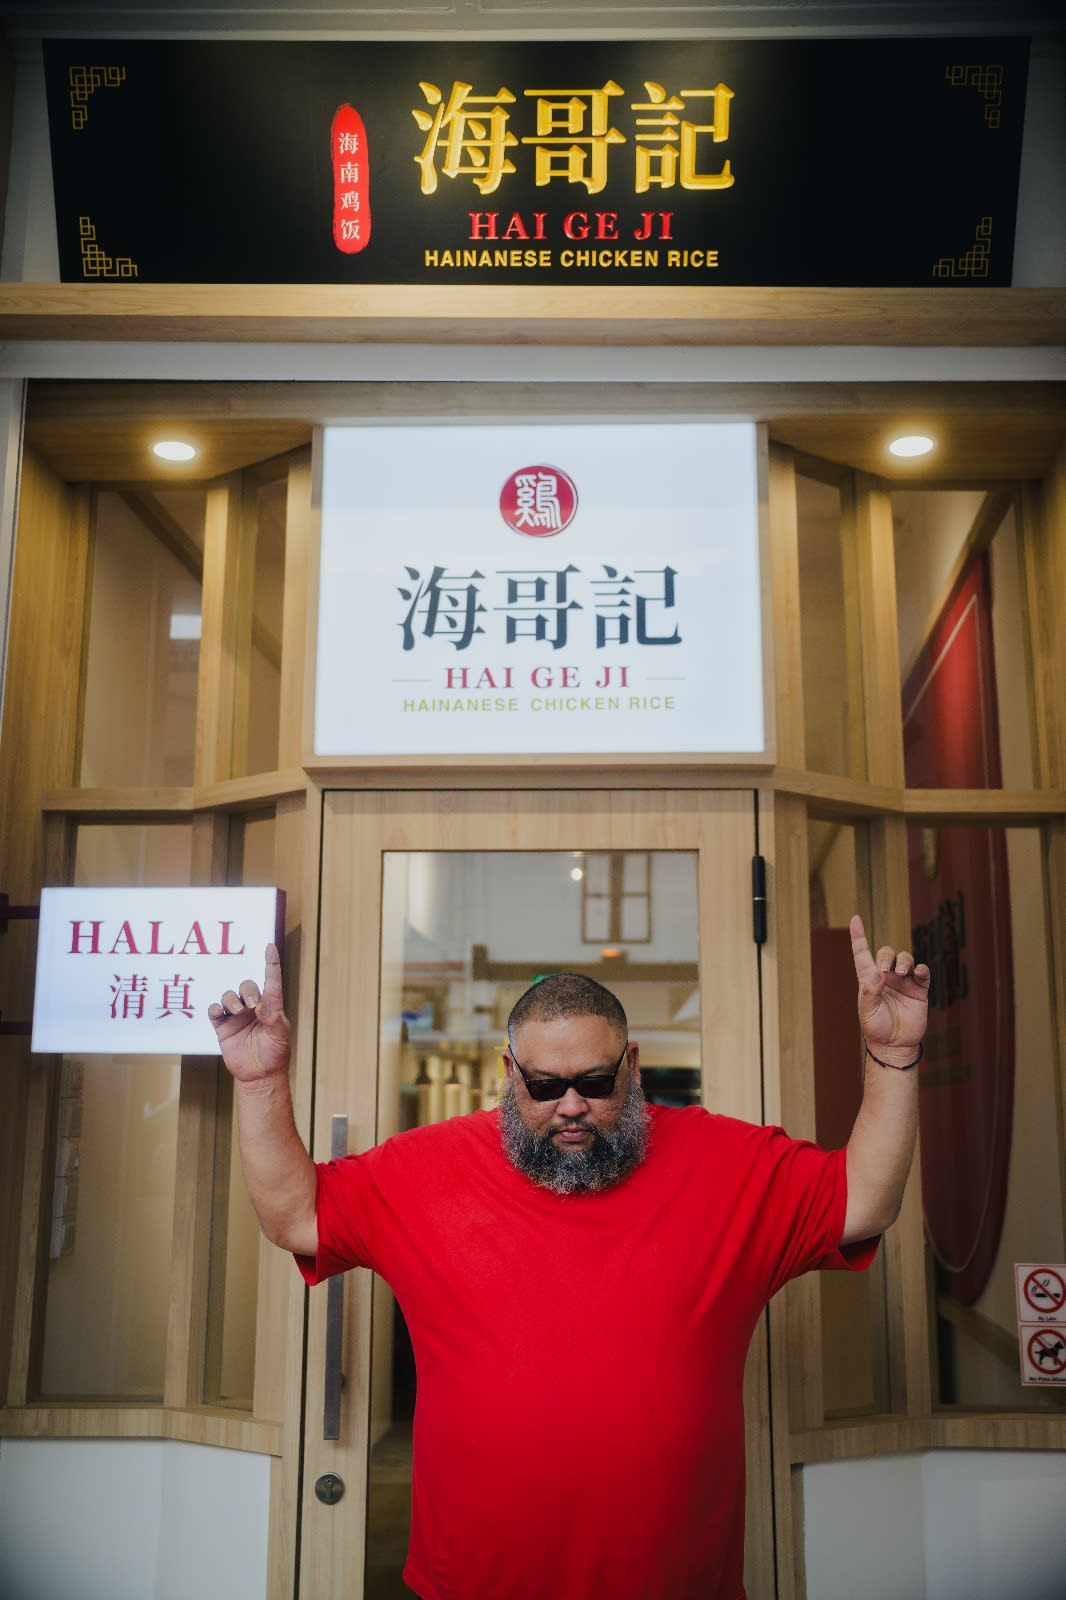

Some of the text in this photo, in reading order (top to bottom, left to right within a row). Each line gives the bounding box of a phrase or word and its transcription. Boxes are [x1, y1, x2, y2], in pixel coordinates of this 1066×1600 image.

[412, 80, 735, 195] 海哥記
[339, 132, 361, 241] 海南鸡饭
[468, 211, 674, 240] HAI GE JI
[424, 249, 719, 268] HAINANESE CHICKEN RICE
[396, 563, 683, 651] 海哥記
[445, 666, 630, 689] HAI GE JI
[403, 696, 676, 713] HAINANESE CHICKEN RICE
[67, 920, 246, 955] HALAL
[109, 973, 195, 1019] 清真
